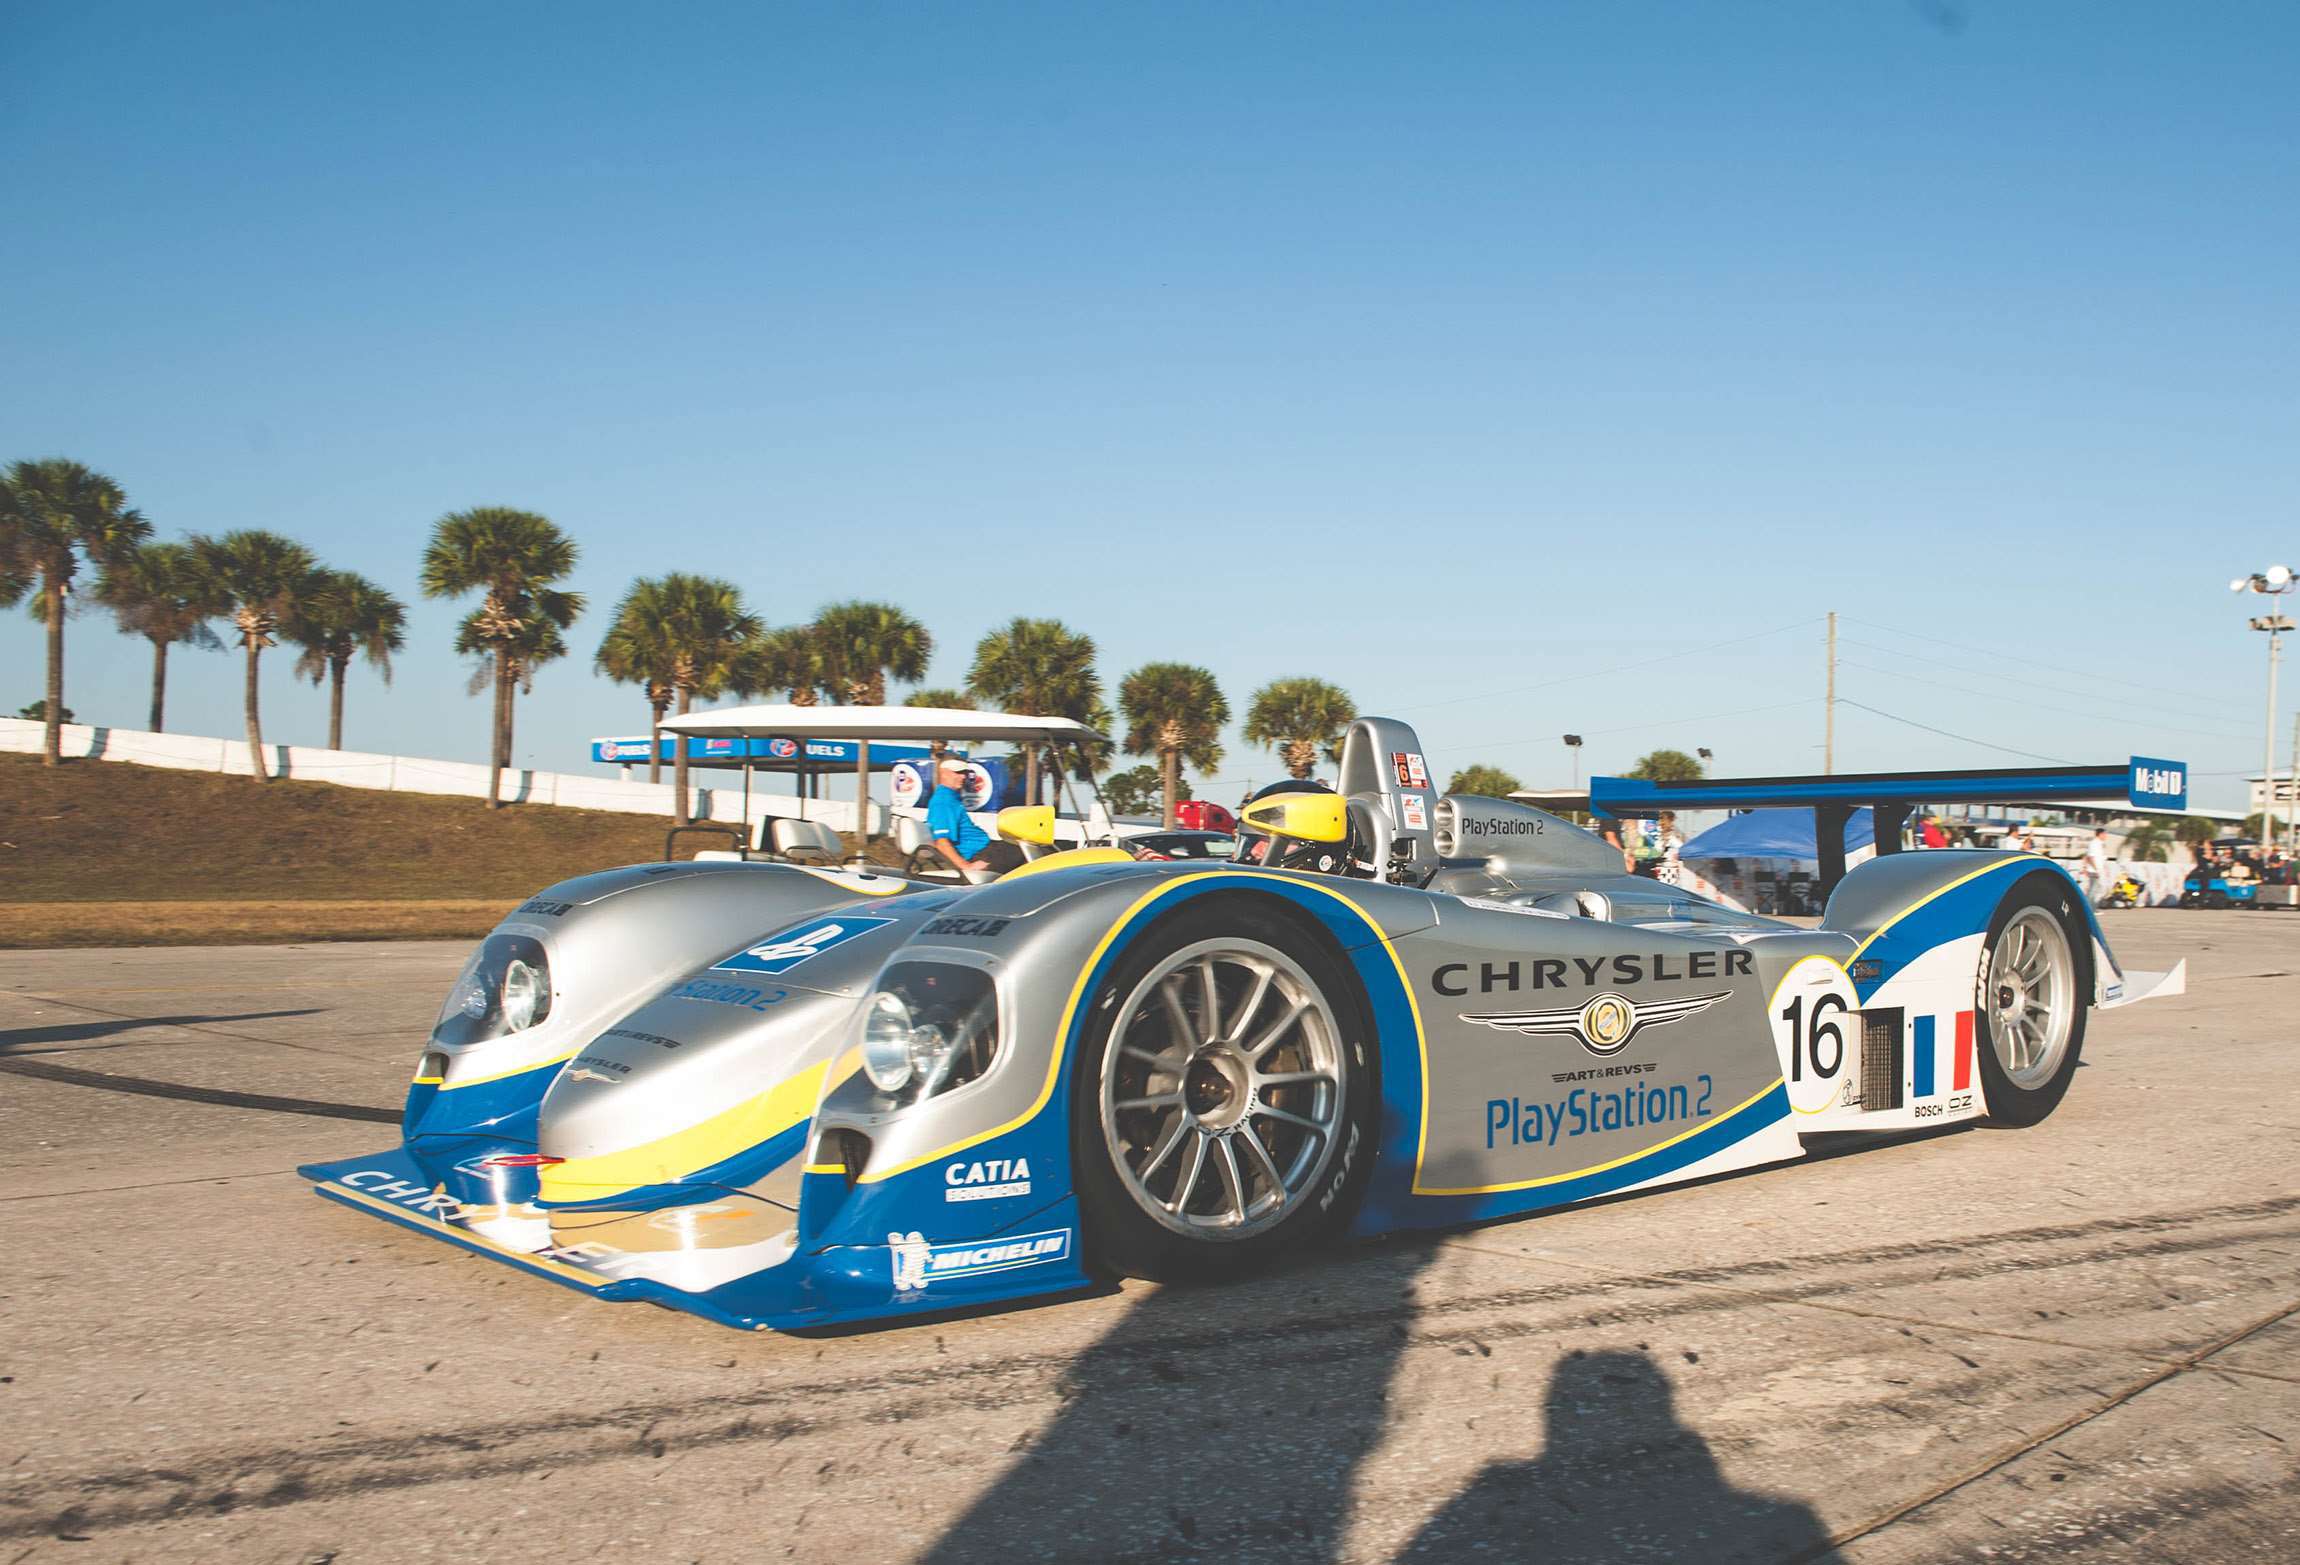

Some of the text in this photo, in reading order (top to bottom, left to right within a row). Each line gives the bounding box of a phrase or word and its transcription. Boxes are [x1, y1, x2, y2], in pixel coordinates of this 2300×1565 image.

[803, 744, 846, 757] UELS
[2135, 767, 2169, 794] Mobil
[1462, 818, 1544, 836] PlayStation 2
[1431, 949, 1754, 997] CHRYSLER
[1781, 993, 1848, 1083] 16
[1566, 1064, 1643, 1082] ART&REVS
[1487, 1074, 1712, 1149] PlayStation 2
[1914, 1104, 1943, 1118] BOSCH
[1949, 1095, 1973, 1109] OZ
[945, 1158, 1031, 1186] CATIA
[930, 1236, 1065, 1271] MICHELIN
